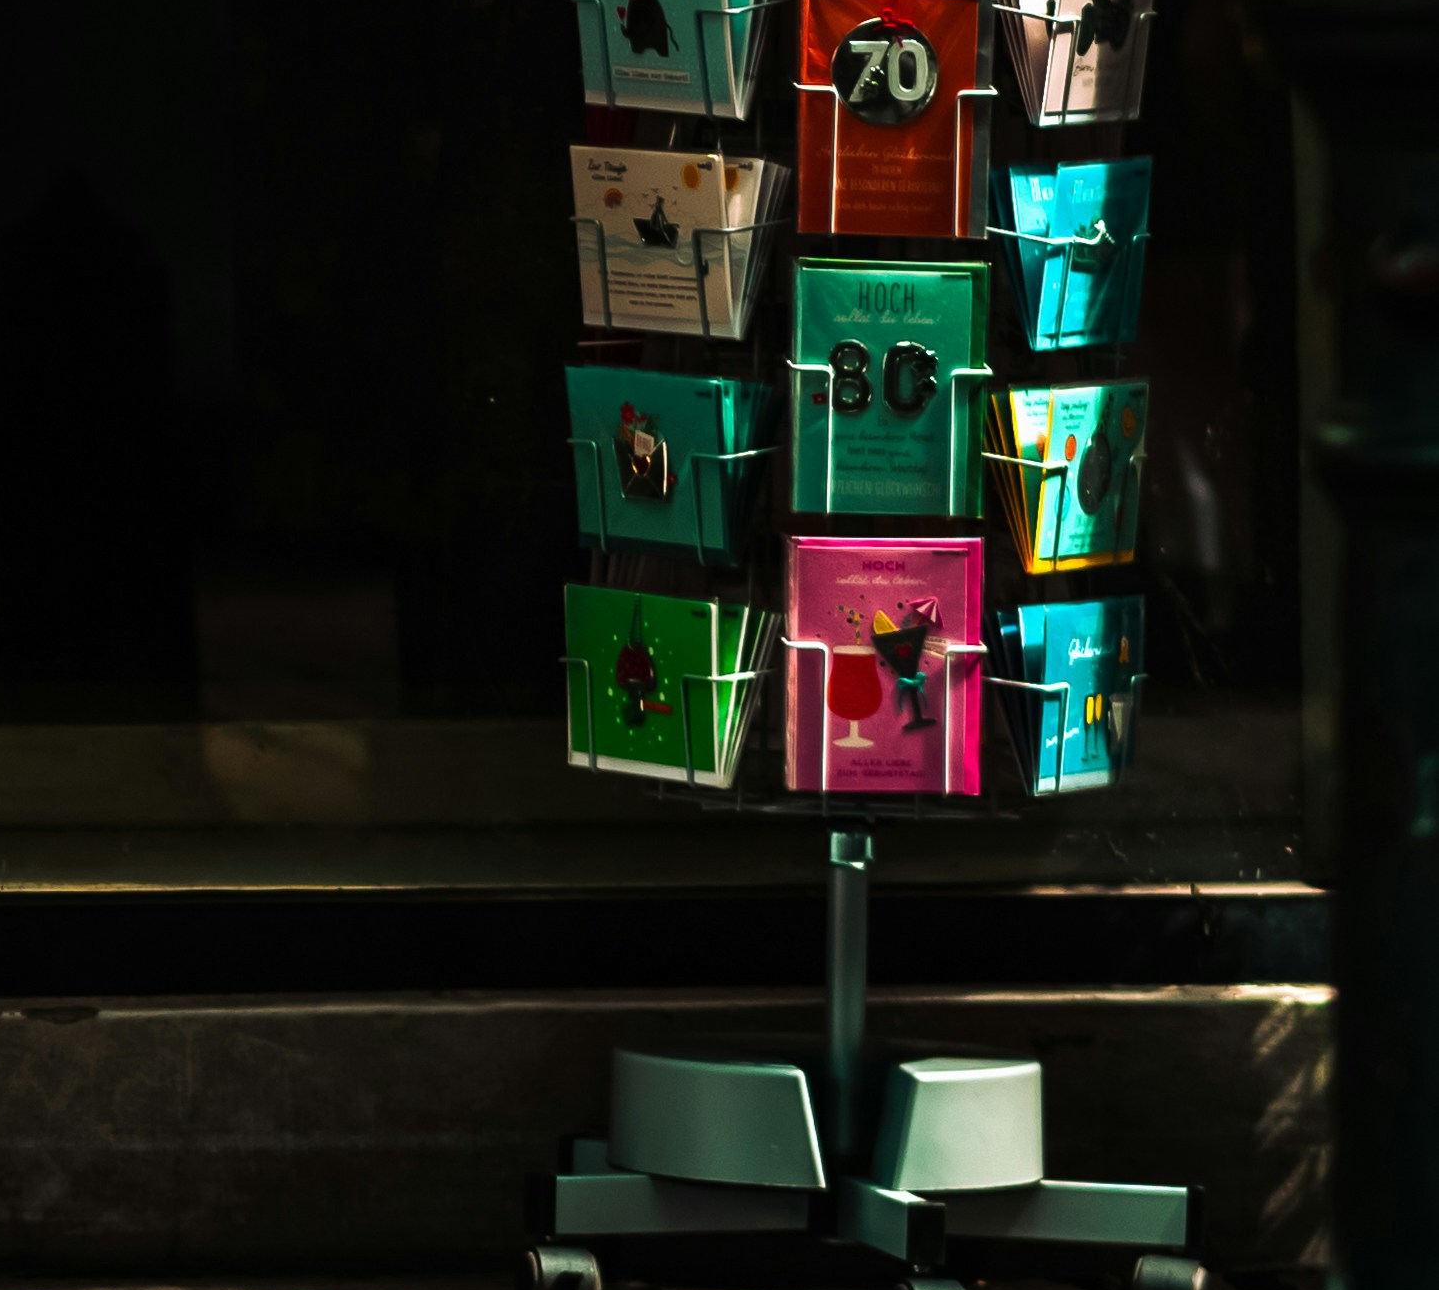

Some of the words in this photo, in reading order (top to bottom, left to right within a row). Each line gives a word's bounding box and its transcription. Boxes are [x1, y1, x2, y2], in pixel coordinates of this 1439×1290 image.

[848, 38, 930, 103] 70
[857, 281, 916, 314] HOCH
[829, 338, 939, 421] 80
[862, 560, 905, 571] HOCH
